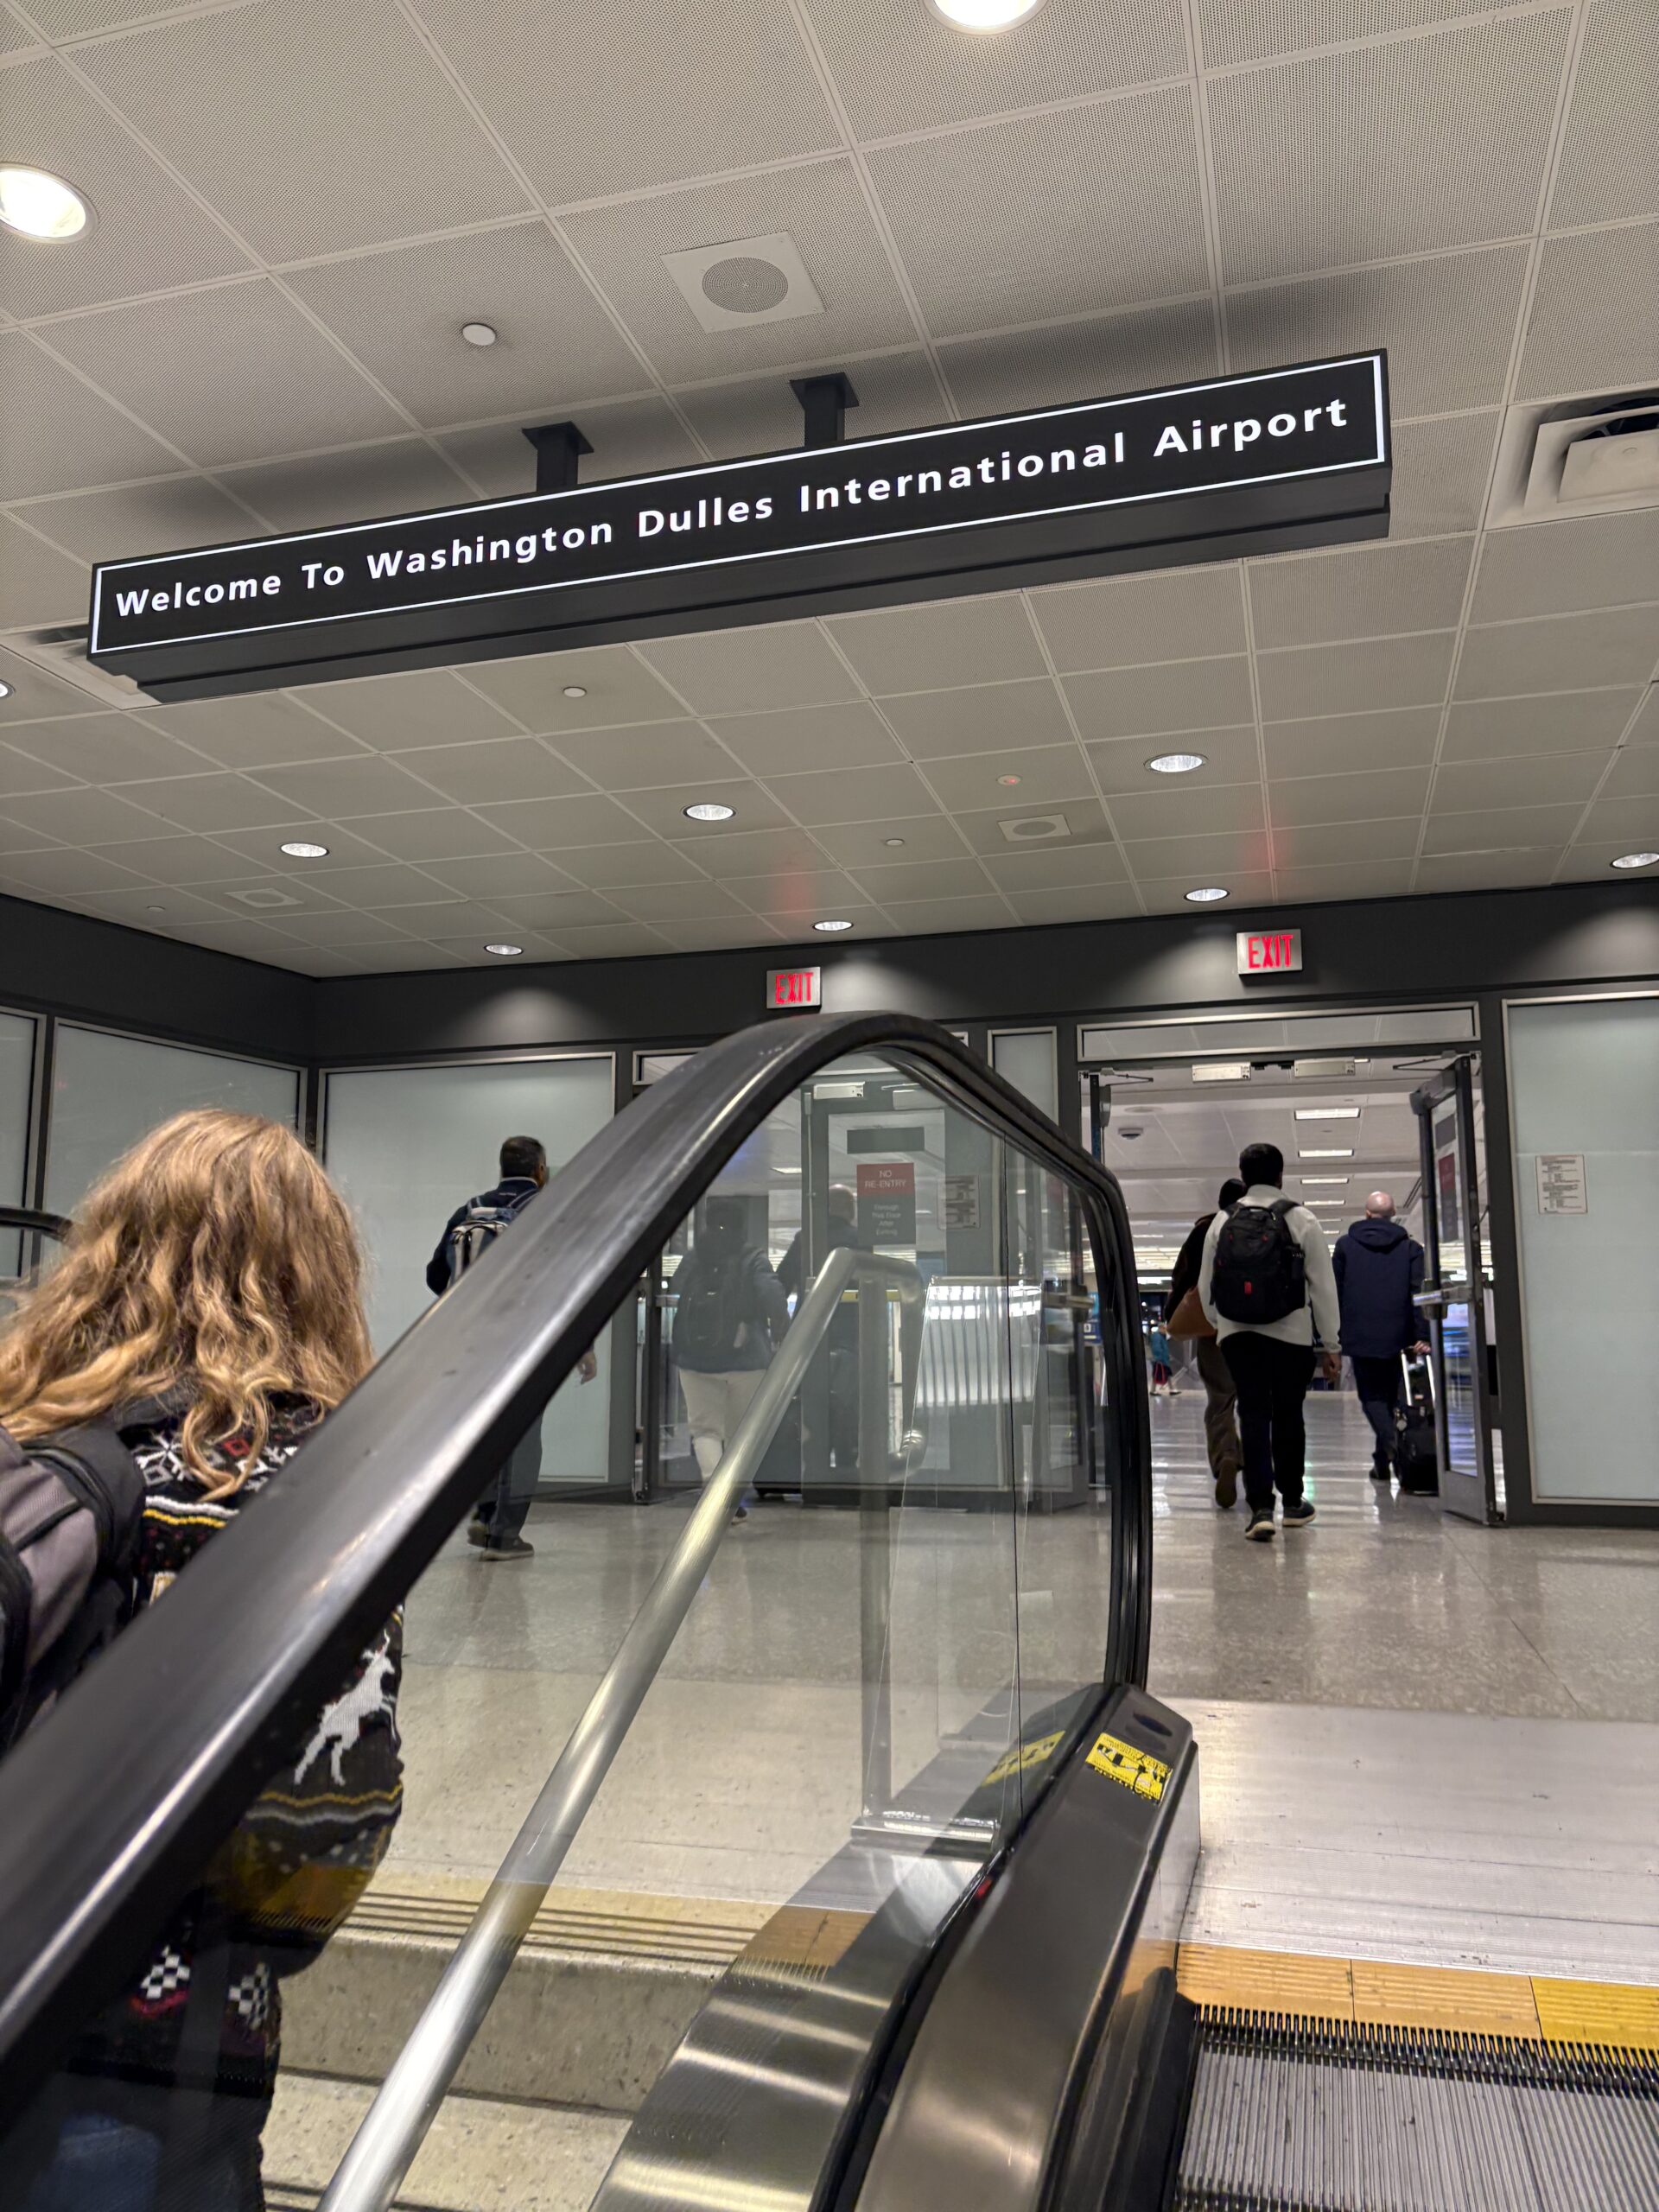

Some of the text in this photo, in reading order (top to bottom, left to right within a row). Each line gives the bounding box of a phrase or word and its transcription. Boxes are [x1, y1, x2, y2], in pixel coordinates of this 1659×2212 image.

[116, 398, 1348, 617] Welcome To Washington Dulles International Airport
[1247, 933, 1294, 969] EXIT
[775, 971, 814, 1004] EXIT
[864, 1179, 907, 1189] RE-ENTRY
[879, 1169, 893, 1179] NO
